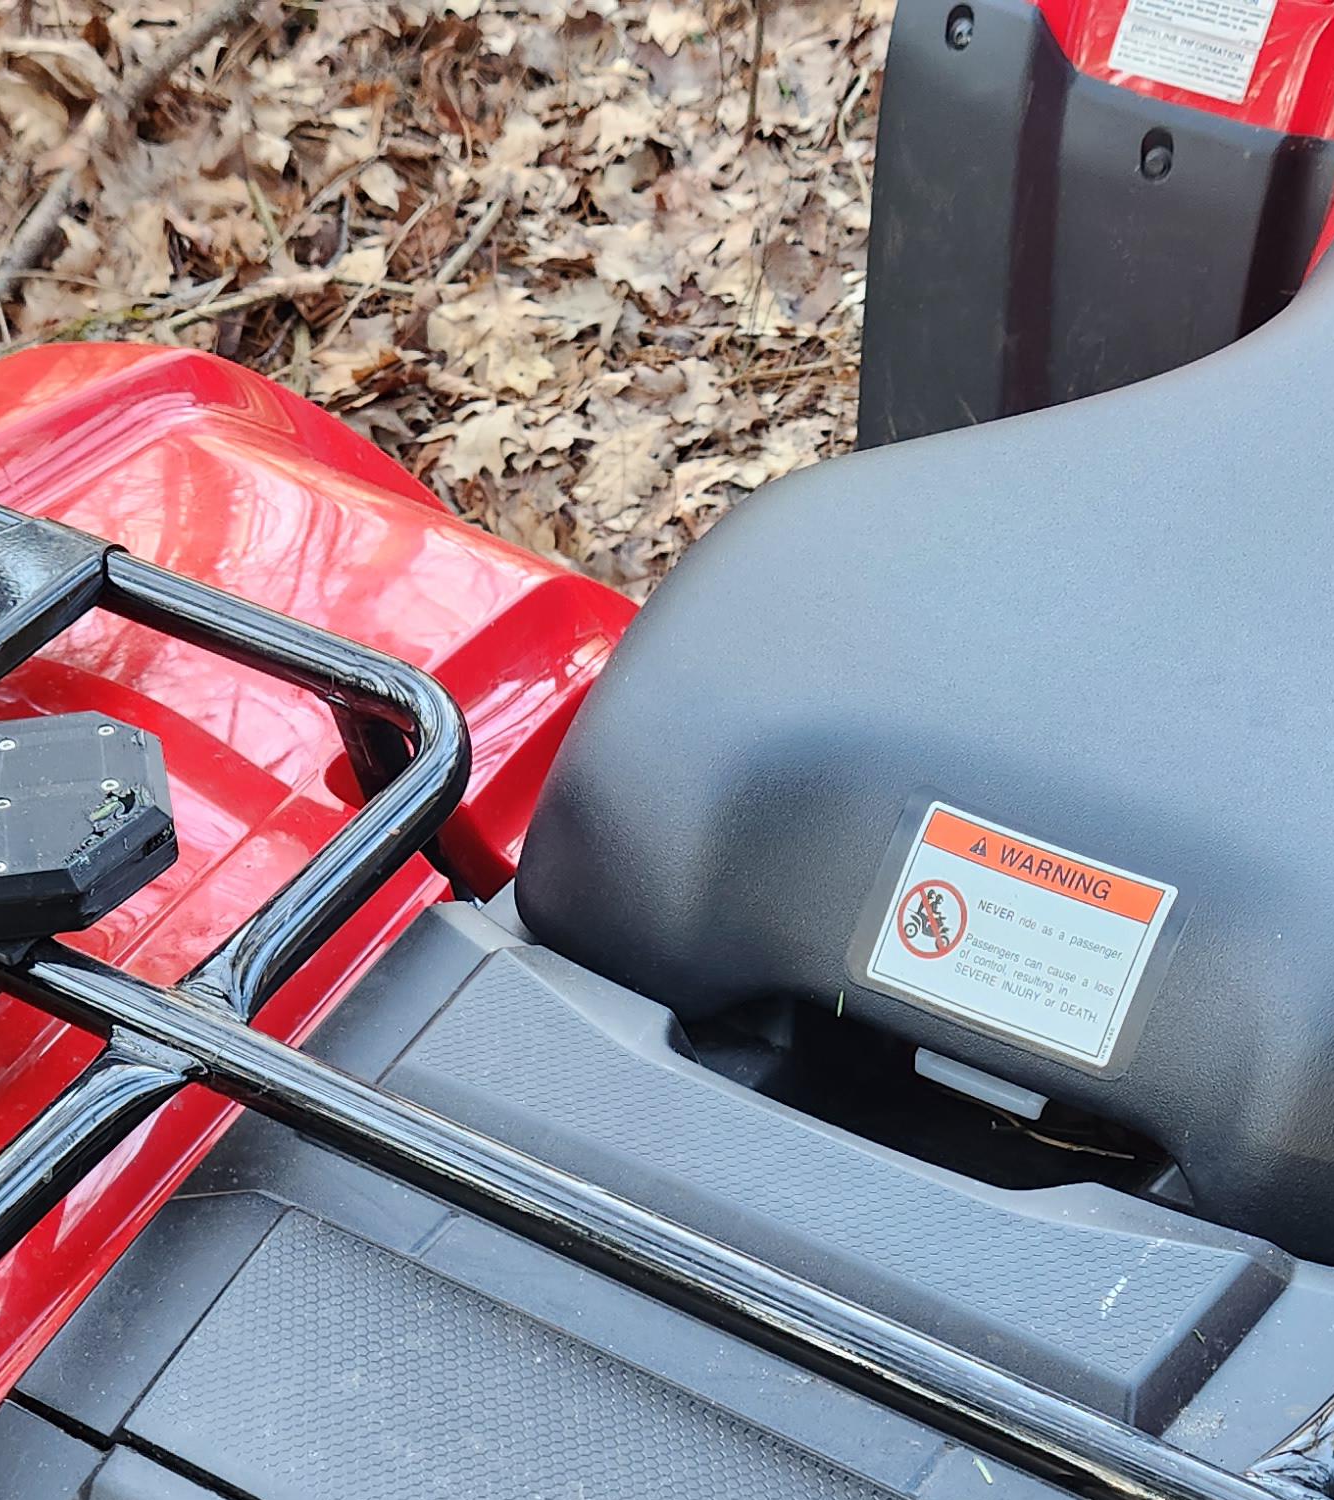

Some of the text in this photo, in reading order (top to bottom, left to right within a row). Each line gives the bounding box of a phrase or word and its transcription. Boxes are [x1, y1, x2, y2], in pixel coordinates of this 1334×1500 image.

[1179, 38, 1245, 61] INFORMATION
[1000, 844, 1112, 901] WARNING
[977, 899, 1123, 961] NEVER ride as a passenger.
[954, 961, 998, 987] SEVERE
[1001, 978, 1042, 1004] INJURY
[1044, 998, 1056, 1008] or
[959, 948, 971, 959] of
[1012, 969, 1055, 994] resulting
[1058, 982, 1069, 997] in
[964, 932, 1115, 997] Passengers can cause a loss
